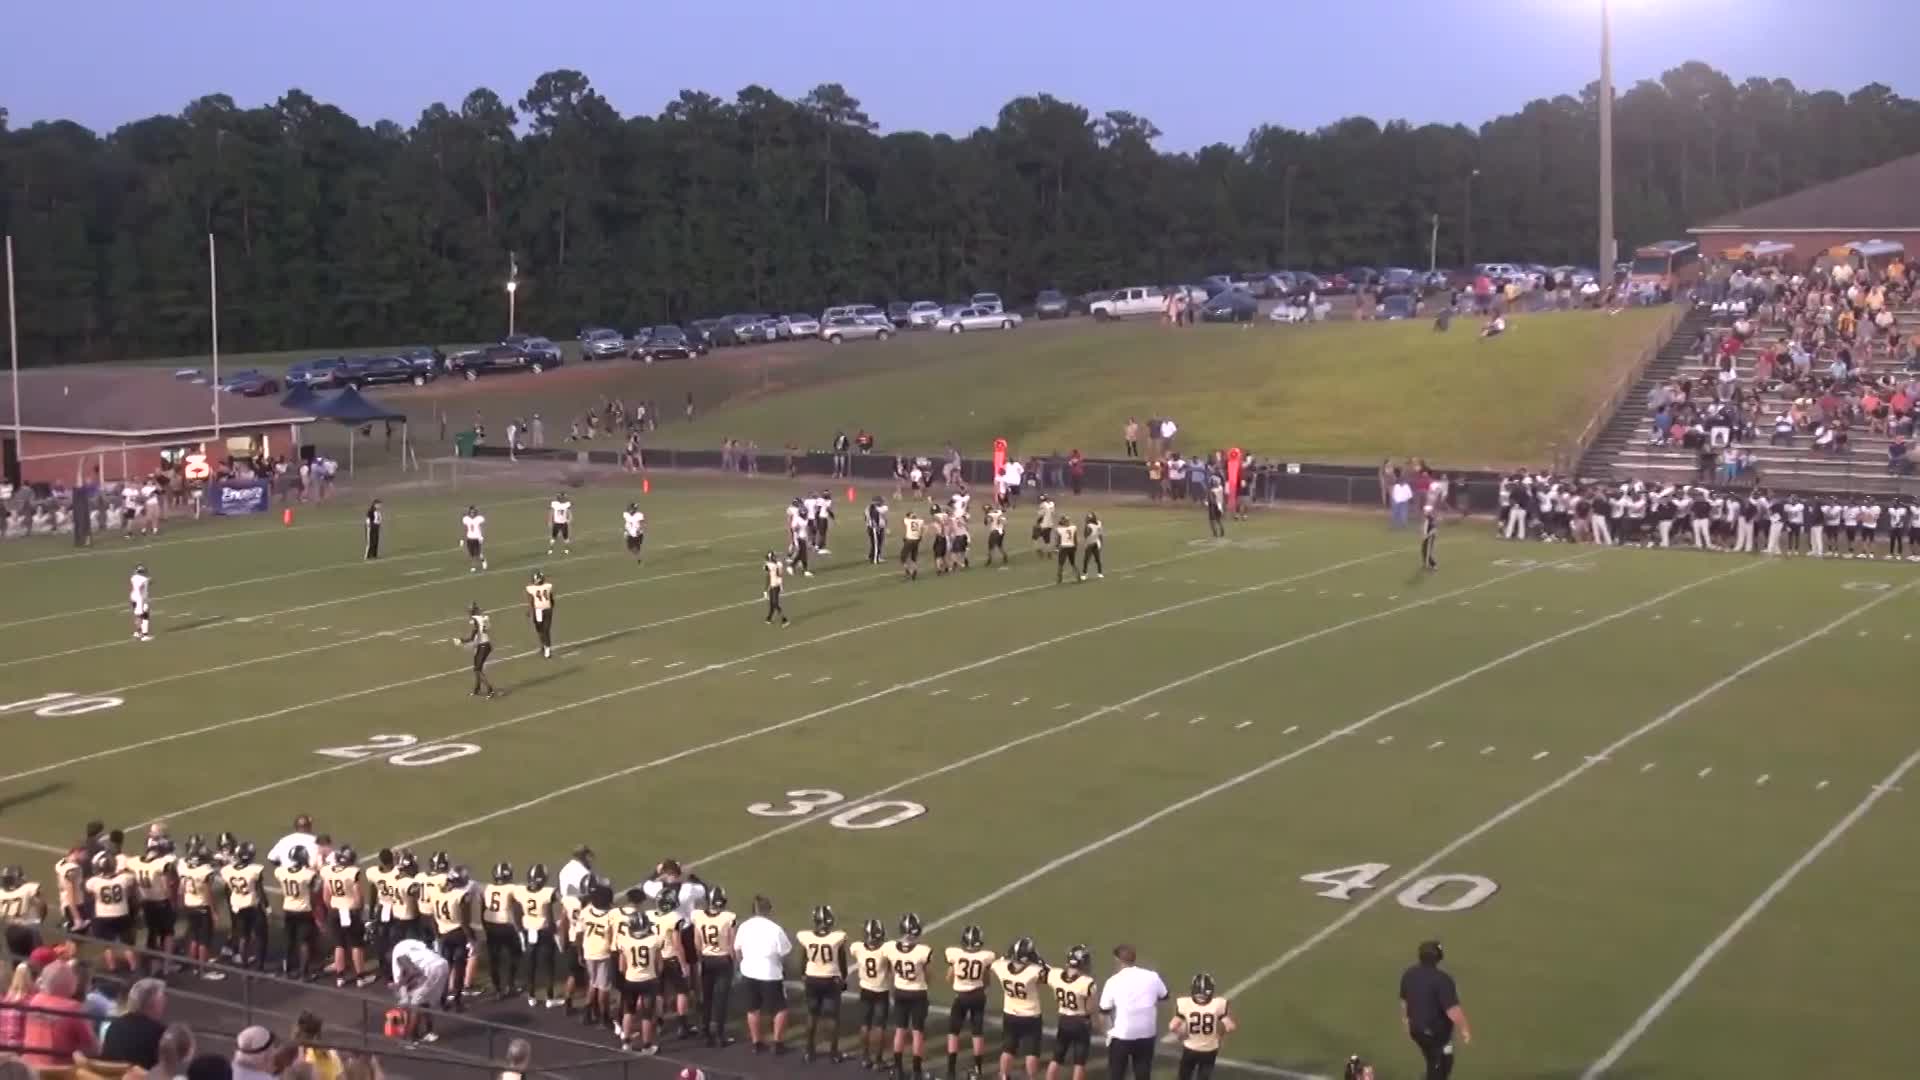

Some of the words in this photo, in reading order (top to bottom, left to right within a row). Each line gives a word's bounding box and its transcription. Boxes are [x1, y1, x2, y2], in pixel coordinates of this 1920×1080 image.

[314, 734, 481, 765] 20
[747, 789, 926, 829] 30
[284, 879, 300, 898] 10
[1299, 862, 1498, 911] 40
[435, 899, 451, 920] 14
[491, 891, 501, 912] 6
[527, 899, 538, 917] 2
[701, 924, 719, 946] 12
[630, 945, 650, 968] 19
[808, 943, 834, 964] 70
[864, 957, 878, 979] 8
[894, 961, 917, 981] 42
[957, 958, 983, 981] 30
[1003, 979, 1027, 1000] 56
[1189, 1011, 1215, 1034] 28
